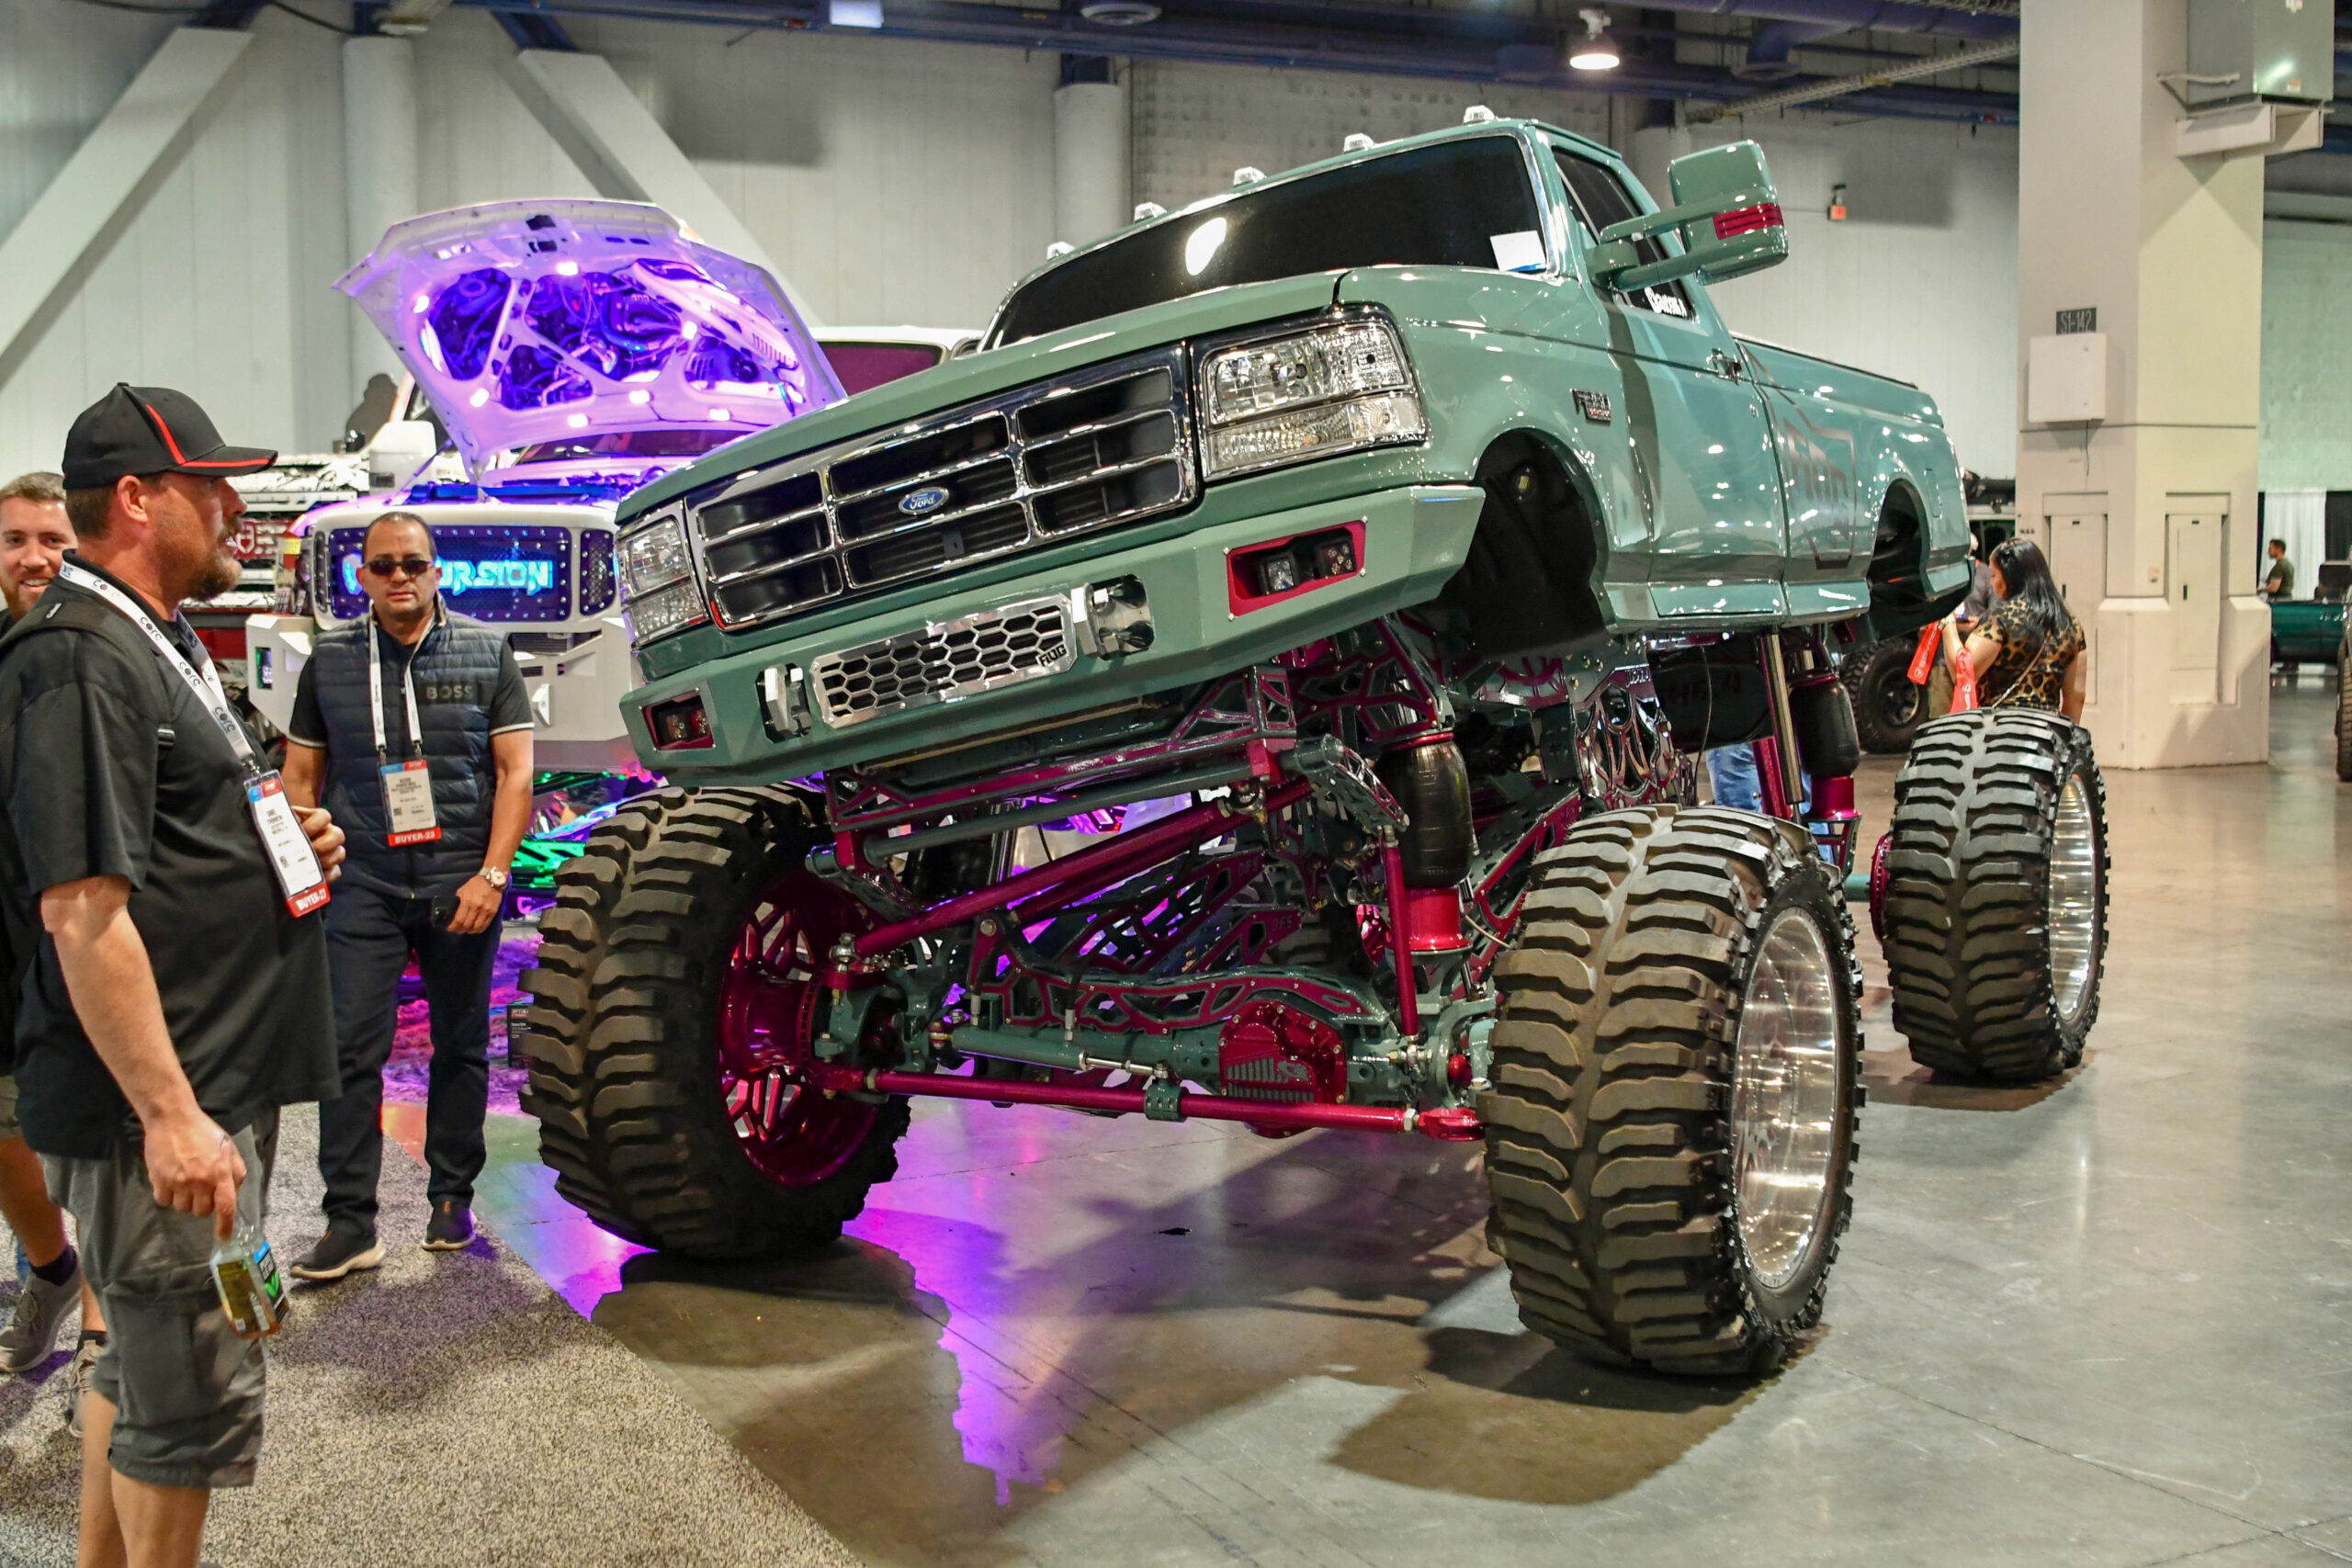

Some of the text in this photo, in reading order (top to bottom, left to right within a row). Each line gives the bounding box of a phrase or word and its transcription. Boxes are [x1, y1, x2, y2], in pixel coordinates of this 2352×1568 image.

[910, 492, 935, 510] Ford
[140, 616, 163, 641] core
[179, 660, 201, 687] core
[425, 684, 473, 699] BOSS
[214, 706, 236, 733] core
[394, 830, 435, 844] BUYER-23
